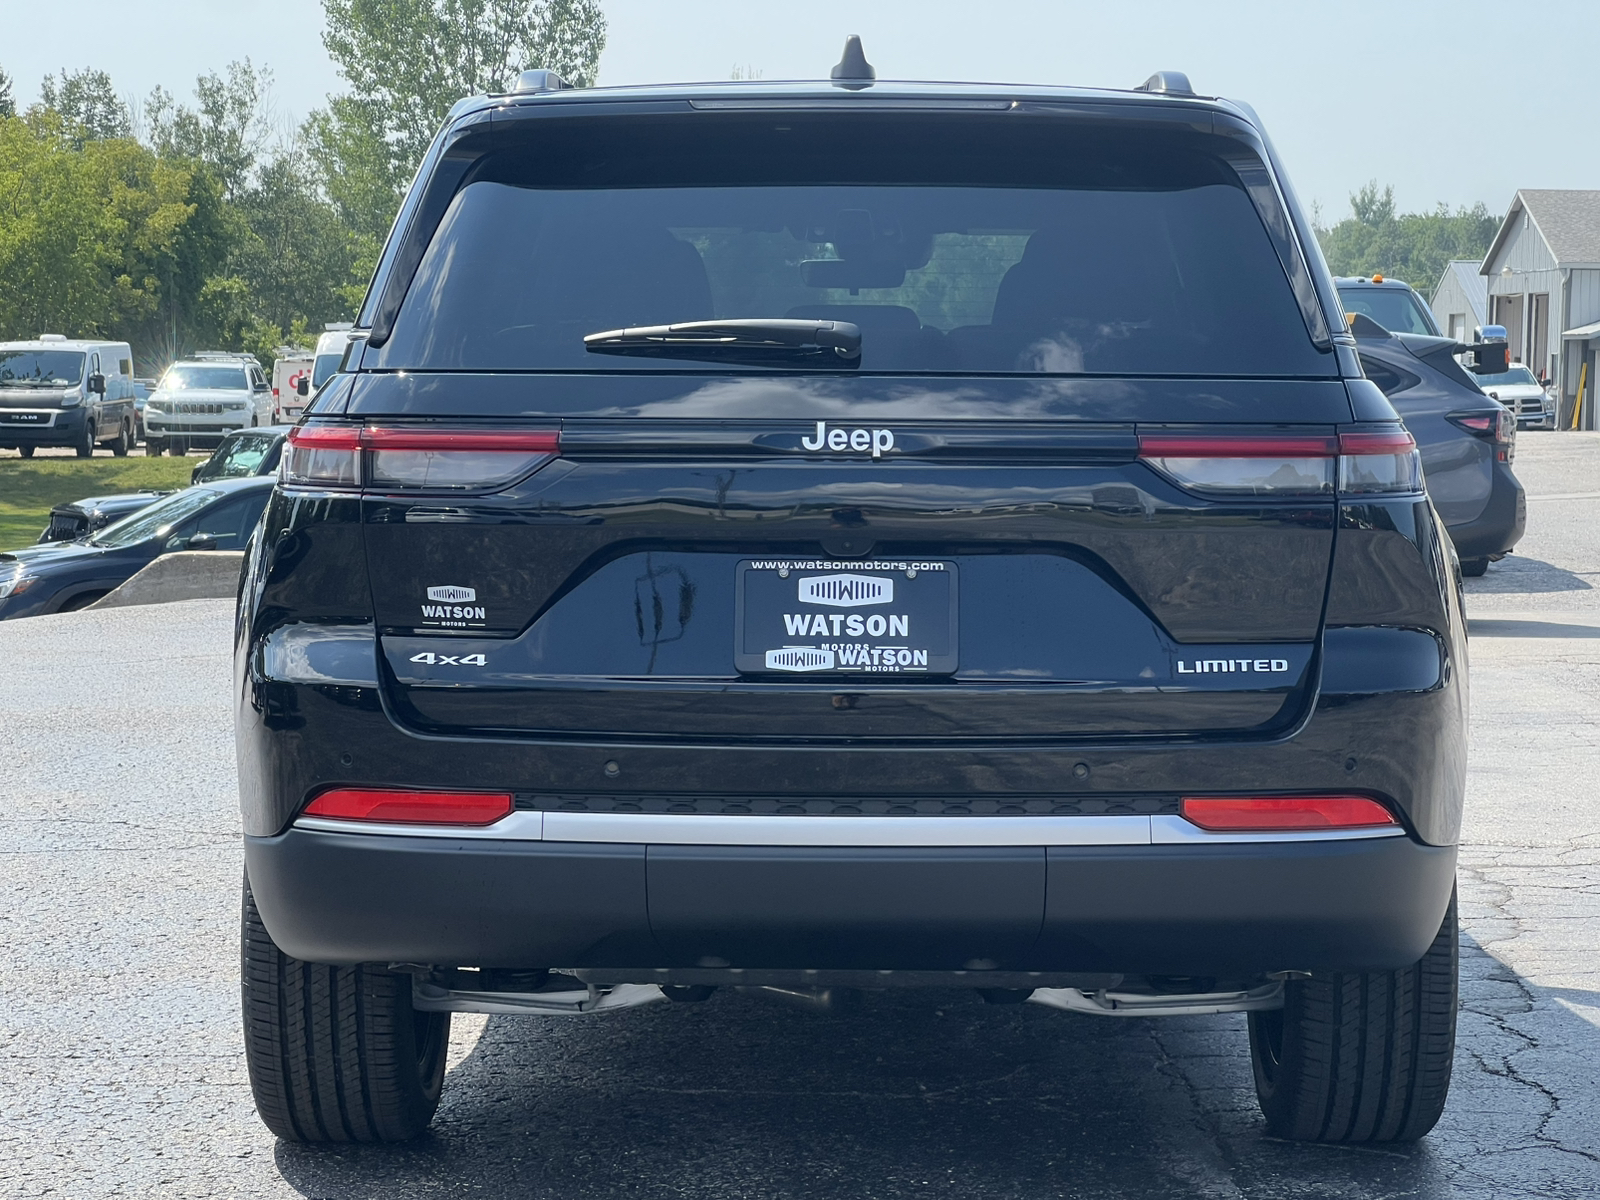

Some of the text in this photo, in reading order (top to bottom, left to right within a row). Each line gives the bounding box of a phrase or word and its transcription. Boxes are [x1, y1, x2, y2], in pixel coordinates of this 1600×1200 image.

[802, 421, 894, 457] Jeep
[751, 560, 944, 571] www.watsonmotors.com
[421, 605, 486, 619] WATSON
[783, 614, 909, 637] WATSON
[821, 643, 870, 651] MOTORS
[409, 652, 489, 667] 4x4
[838, 650, 928, 666] WATSON
[1177, 659, 1289, 673] LIMITED
